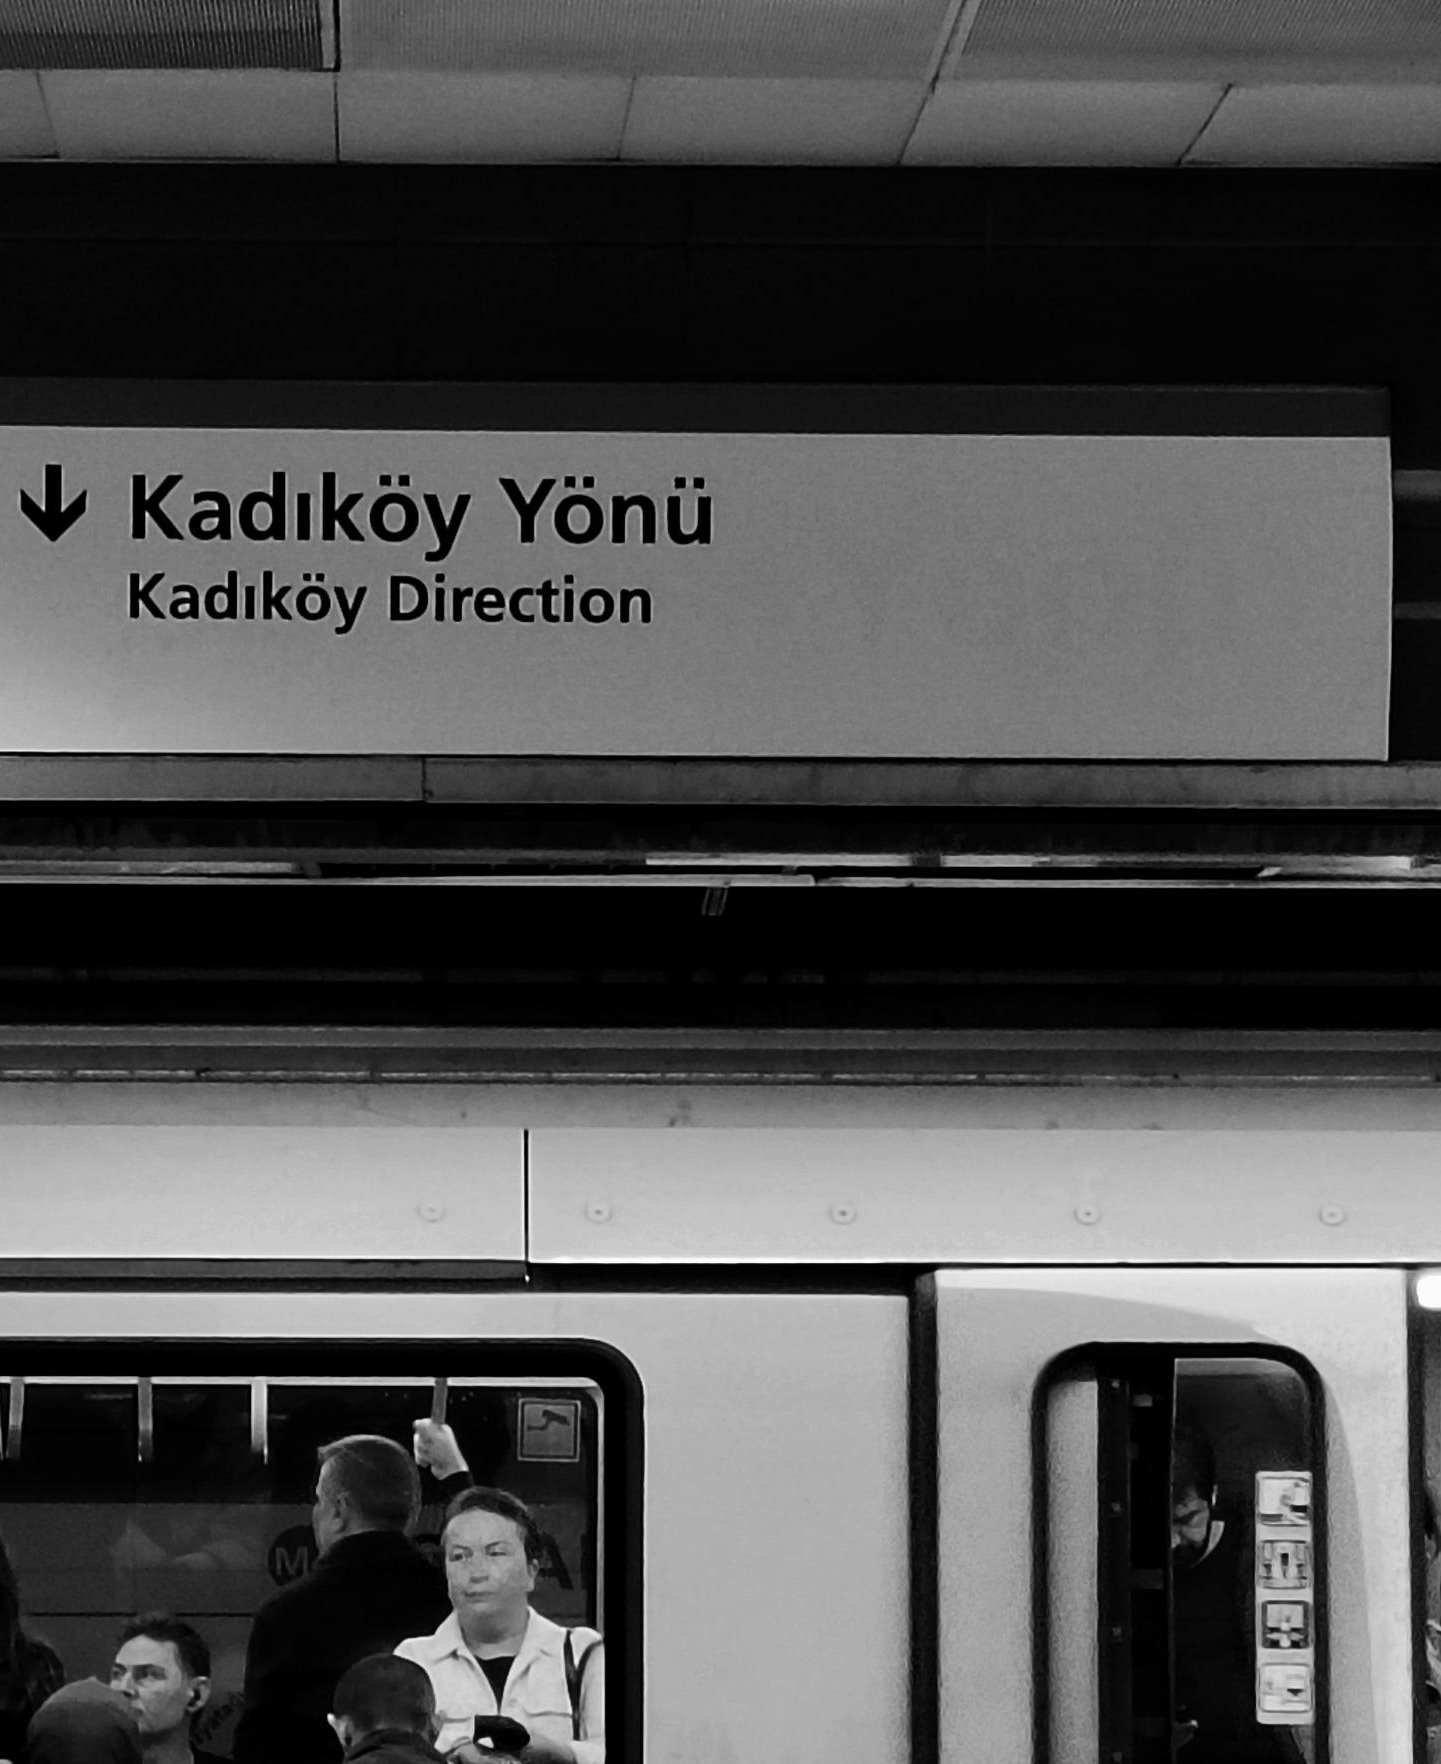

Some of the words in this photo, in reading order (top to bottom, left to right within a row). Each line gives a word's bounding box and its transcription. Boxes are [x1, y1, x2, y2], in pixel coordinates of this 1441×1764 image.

[130, 470, 471, 562] Kadıköy
[498, 474, 713, 546] Yönü
[128, 569, 368, 634] Kadıköy
[388, 572, 653, 624] Direction
